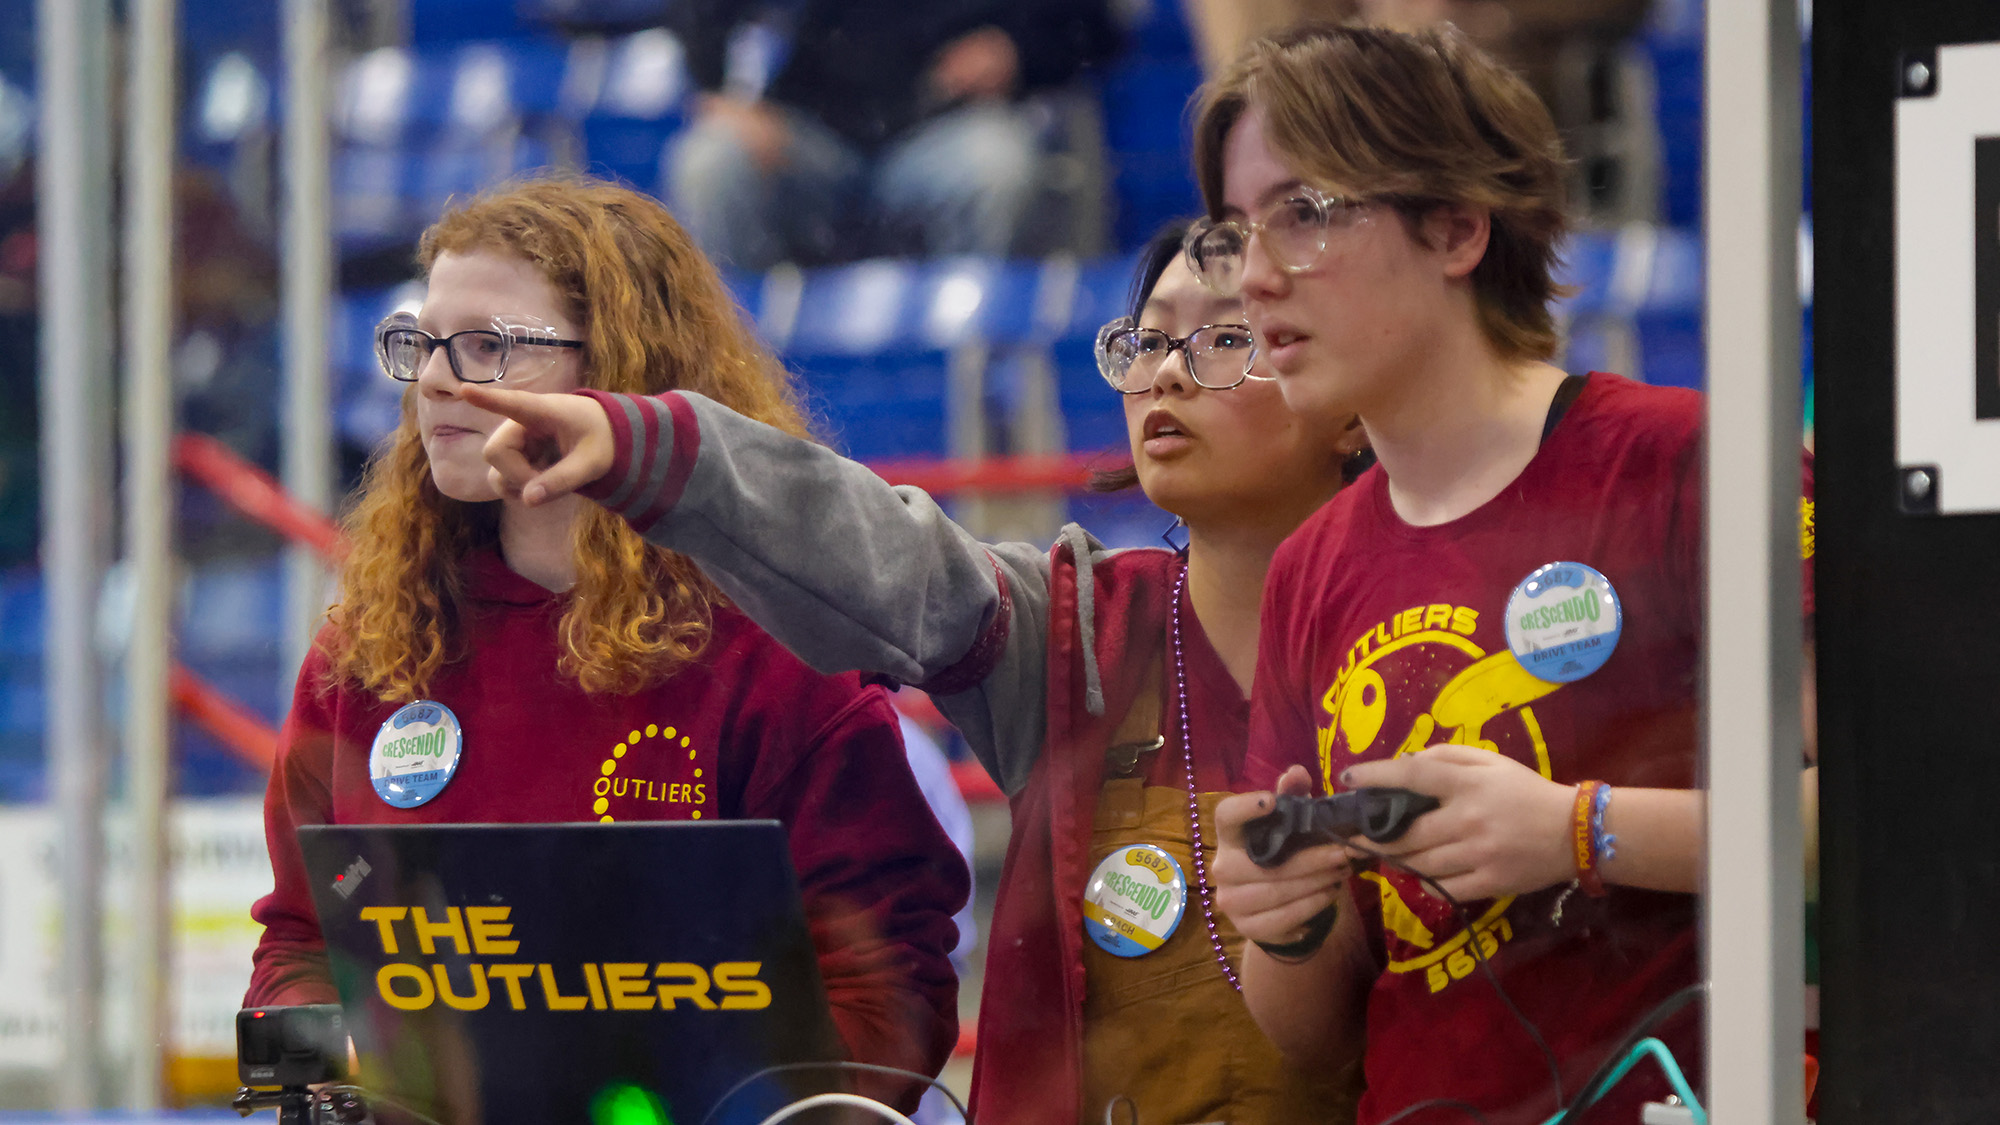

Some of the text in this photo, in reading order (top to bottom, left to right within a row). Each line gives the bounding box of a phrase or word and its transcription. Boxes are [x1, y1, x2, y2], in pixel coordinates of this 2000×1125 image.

[1520, 588, 1600, 631] CRESCENDO
[1322, 603, 1480, 715] OUTLIERS
[1533, 638, 1600, 662] DRIVE TEAM
[402, 708, 435, 724] 5687
[382, 727, 446, 758] CRESCENDO
[412, 772, 438, 783] TEAM
[594, 777, 706, 804] OUTLIERS
[1135, 851, 1169, 873] 5687
[1104, 871, 1172, 920] CRESCENDO
[360, 906, 520, 955] THE
[376, 961, 772, 1011] OUTLIERS
